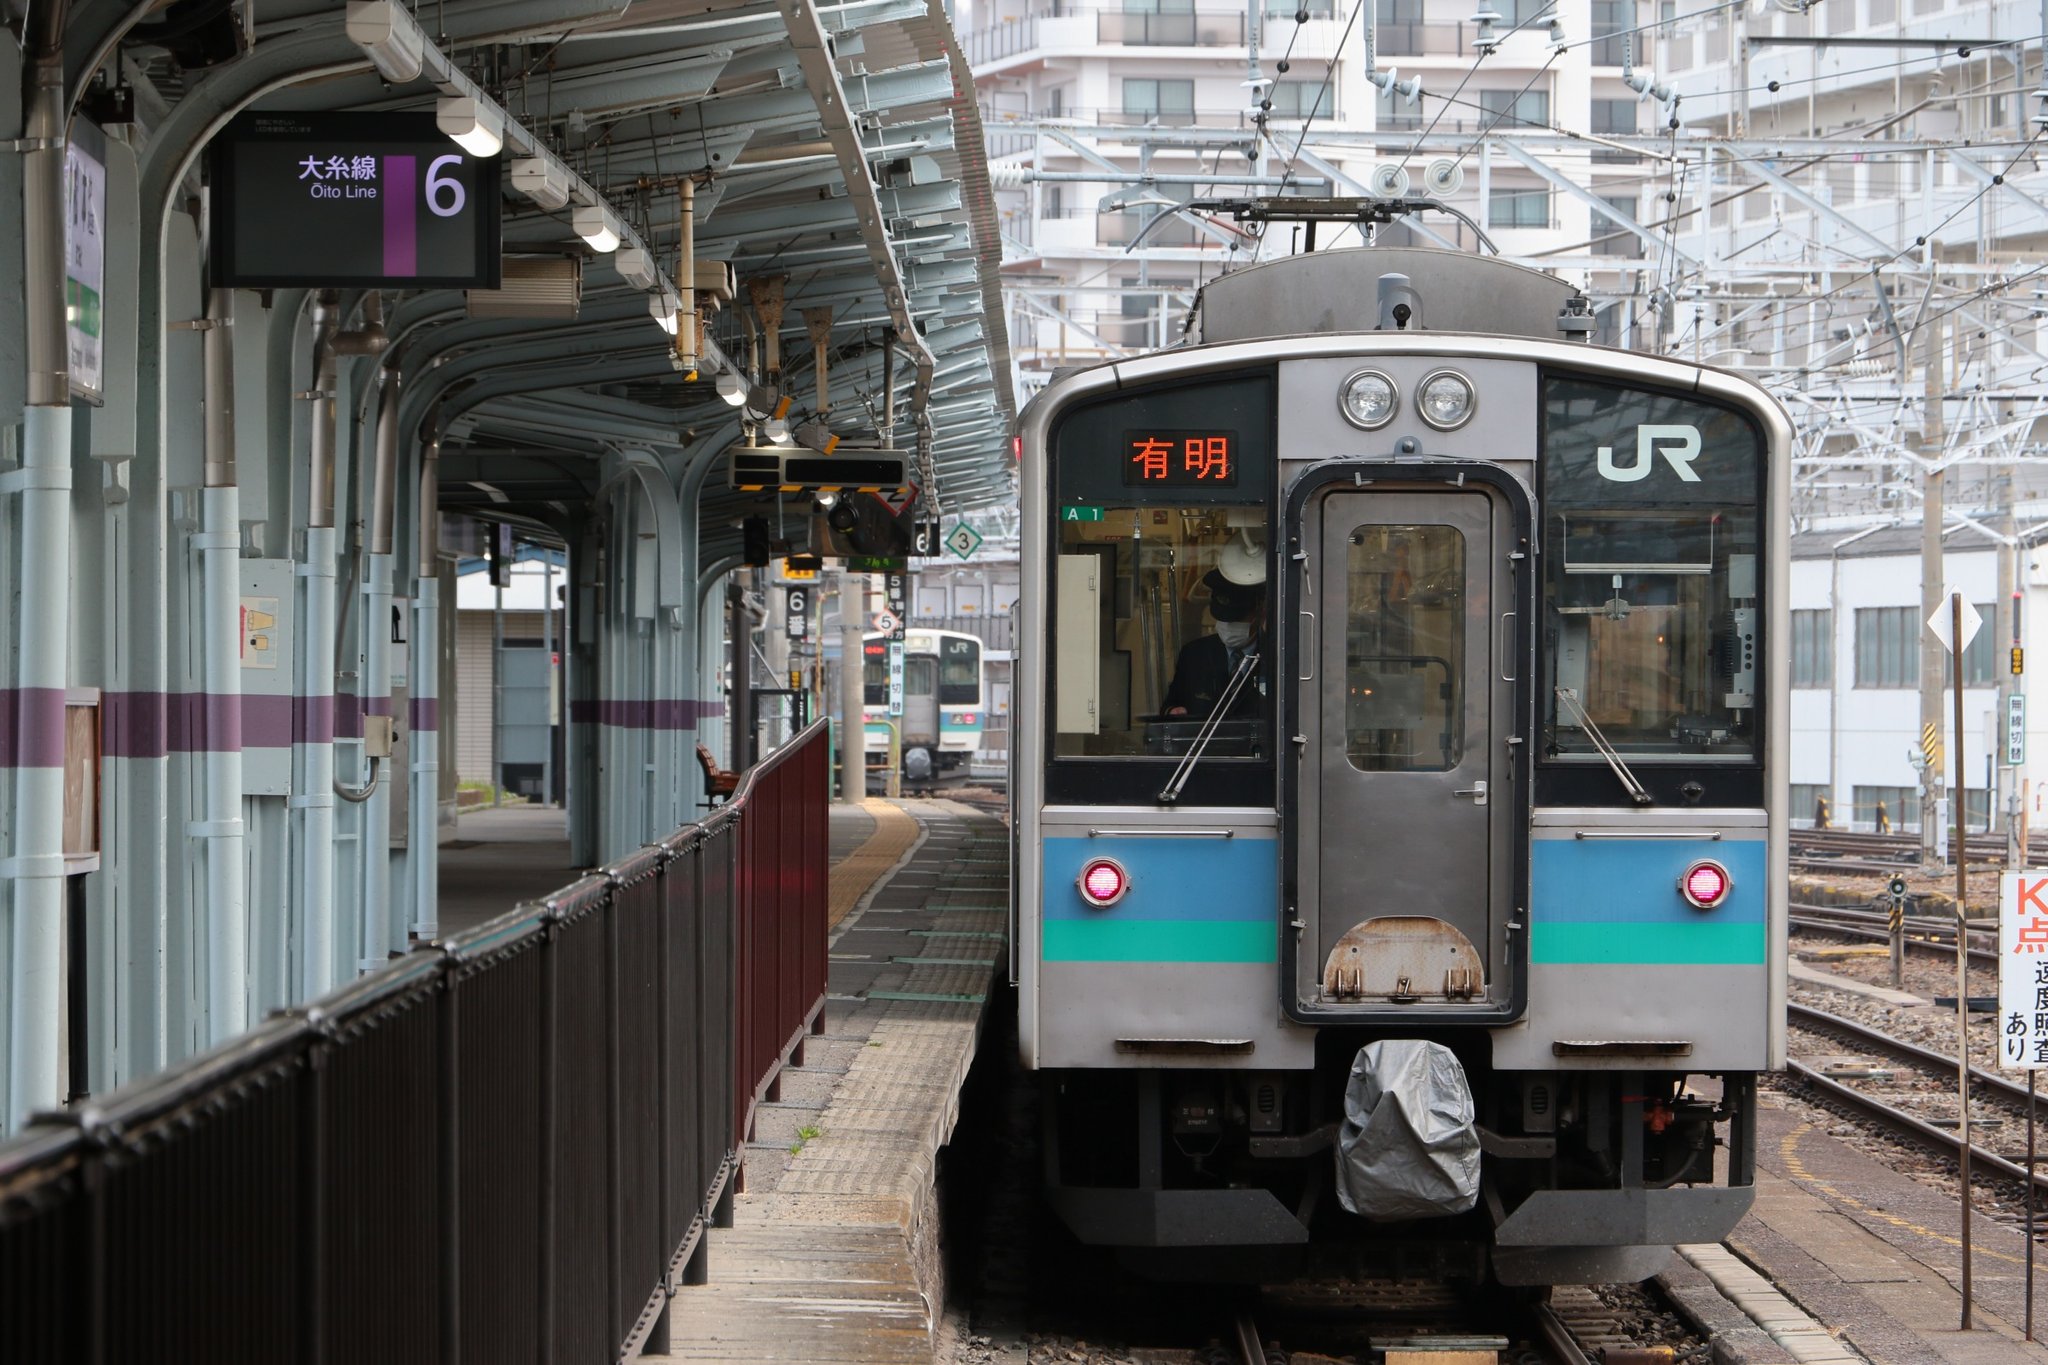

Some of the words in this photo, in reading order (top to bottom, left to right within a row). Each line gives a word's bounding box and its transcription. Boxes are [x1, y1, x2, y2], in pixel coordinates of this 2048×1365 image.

[299, 155, 377, 181] 大糸線
[310, 182, 341, 199] Ōito
[345, 185, 377, 199] Line
[425, 154, 466, 217] 6
[1132, 437, 1228, 479] 有明
[1597, 424, 1702, 482] JR
[1067, 508, 1079, 521] A
[1092, 508, 1098, 521] 1
[916, 533, 929, 552] 6
[958, 532, 970, 550] 3
[788, 591, 805, 635] 6番
[881, 616, 892, 630] 5
[949, 642, 968, 654] JR
[892, 646, 902, 713] 無線切替
[2011, 699, 2022, 760] 無線切替
[2006, 1011, 2027, 1062] あり
